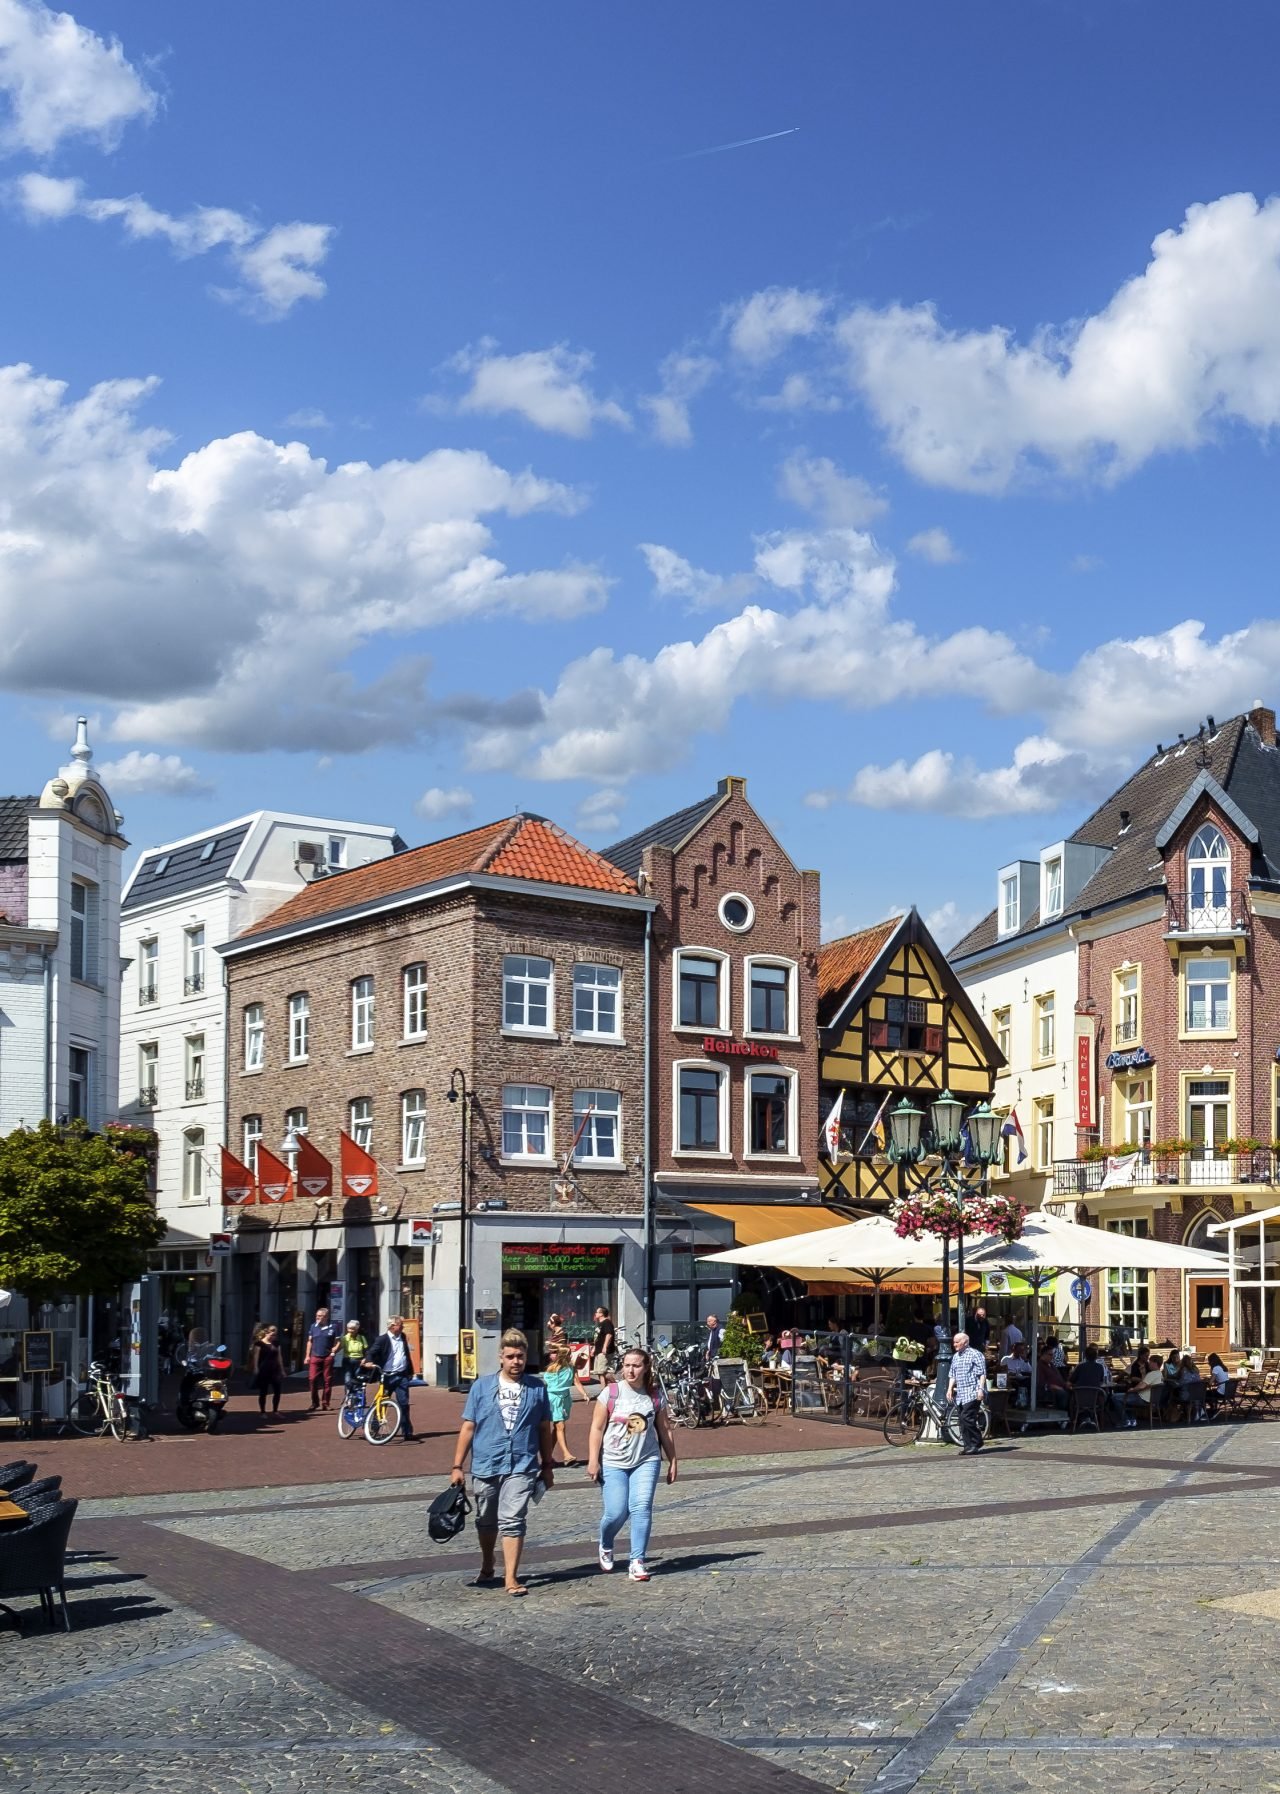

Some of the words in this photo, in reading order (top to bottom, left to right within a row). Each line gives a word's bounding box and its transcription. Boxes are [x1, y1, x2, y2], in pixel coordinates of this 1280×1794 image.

[703, 1036, 779, 1058] Heineken
[1080, 1040, 1088, 1069] WINE
[1107, 1047, 1152, 1068] Bavaria
[1080, 1090, 1088, 1119] DINE
[503, 1244, 609, 1255] arnaval-Grande.com
[524, 1255, 539, 1263] dan
